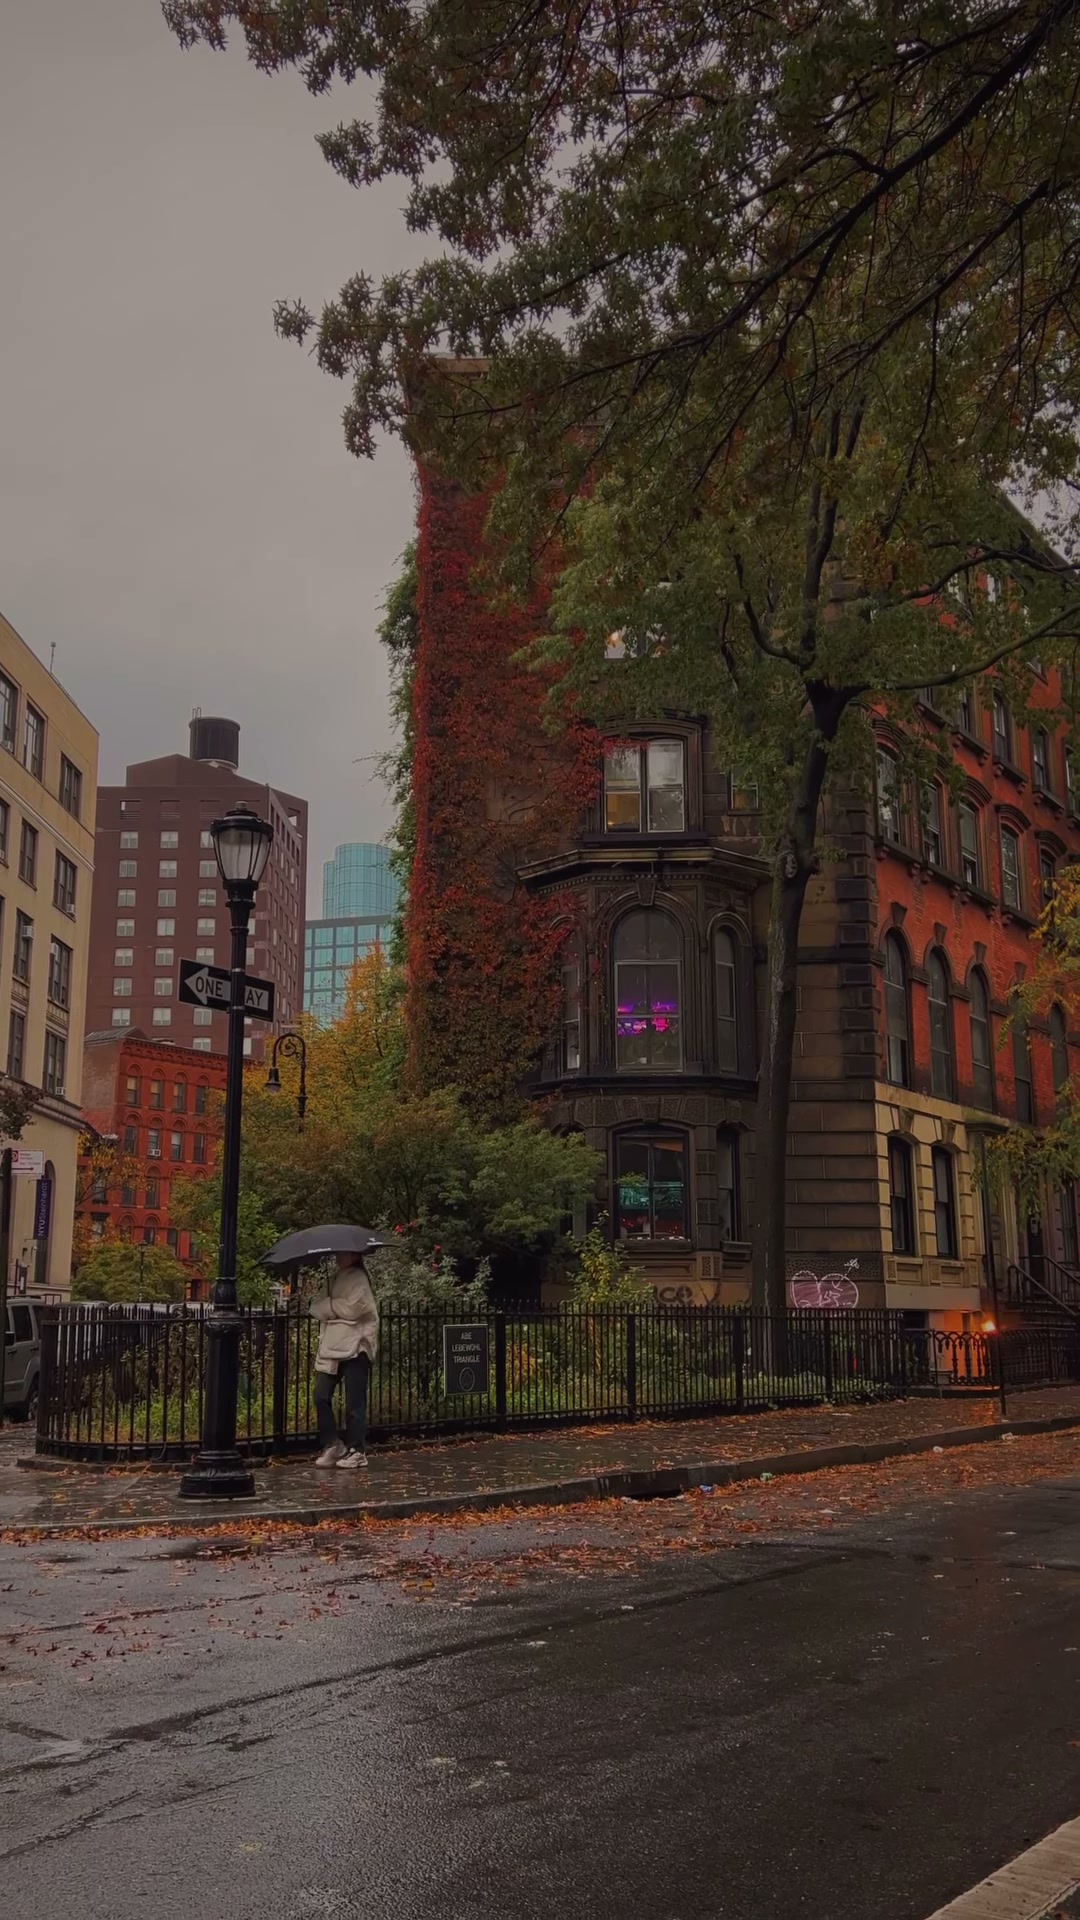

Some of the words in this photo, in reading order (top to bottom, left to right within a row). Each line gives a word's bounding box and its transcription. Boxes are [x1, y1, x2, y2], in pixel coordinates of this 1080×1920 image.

[195, 976, 223, 998] ONE
[245, 989, 264, 1007] AY
[460, 1331, 473, 1340] ABE
[453, 1354, 481, 1364] TRIANGLE
